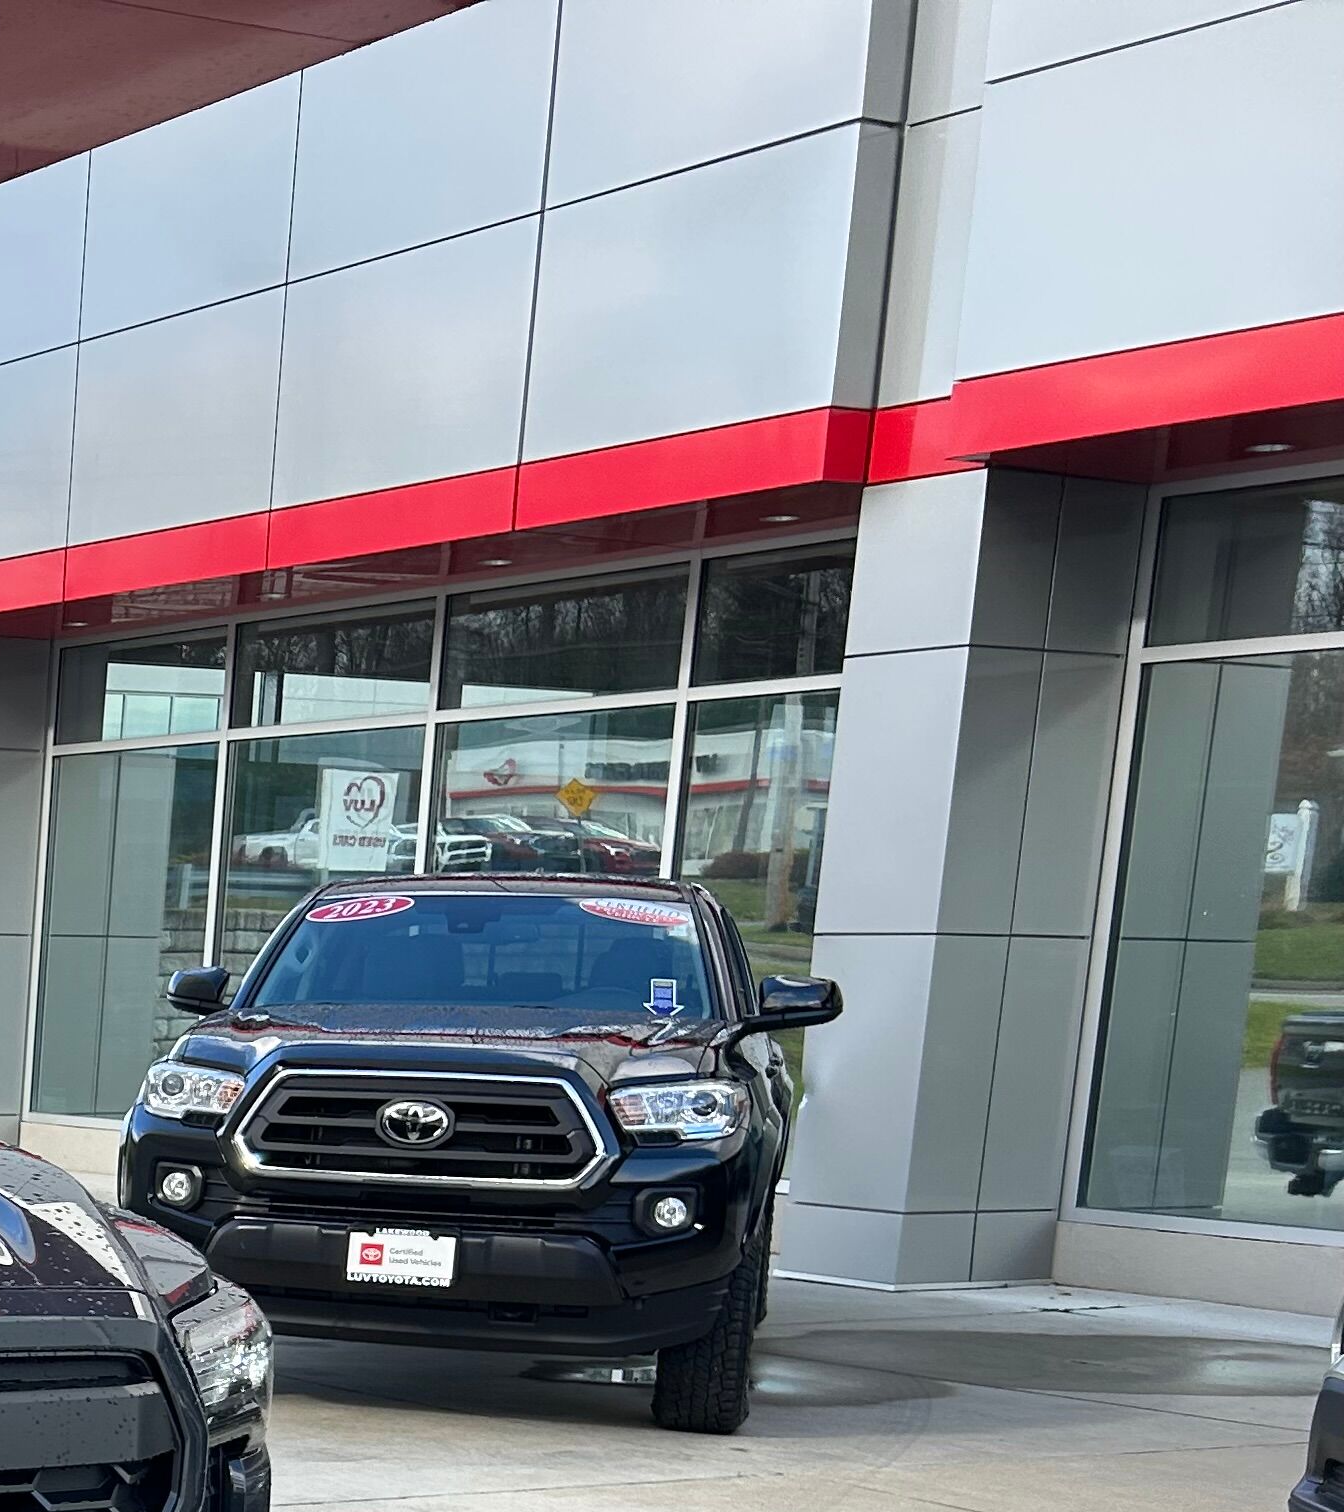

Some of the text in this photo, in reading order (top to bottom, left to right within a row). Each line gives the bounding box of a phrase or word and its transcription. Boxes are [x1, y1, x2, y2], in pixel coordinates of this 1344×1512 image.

[324, 898, 396, 919] 2023
[389, 1247, 424, 1256] Certified
[388, 1257, 442, 1267] Used Vehicles
[347, 1272, 451, 1288] LUVTOYOTA.COM
